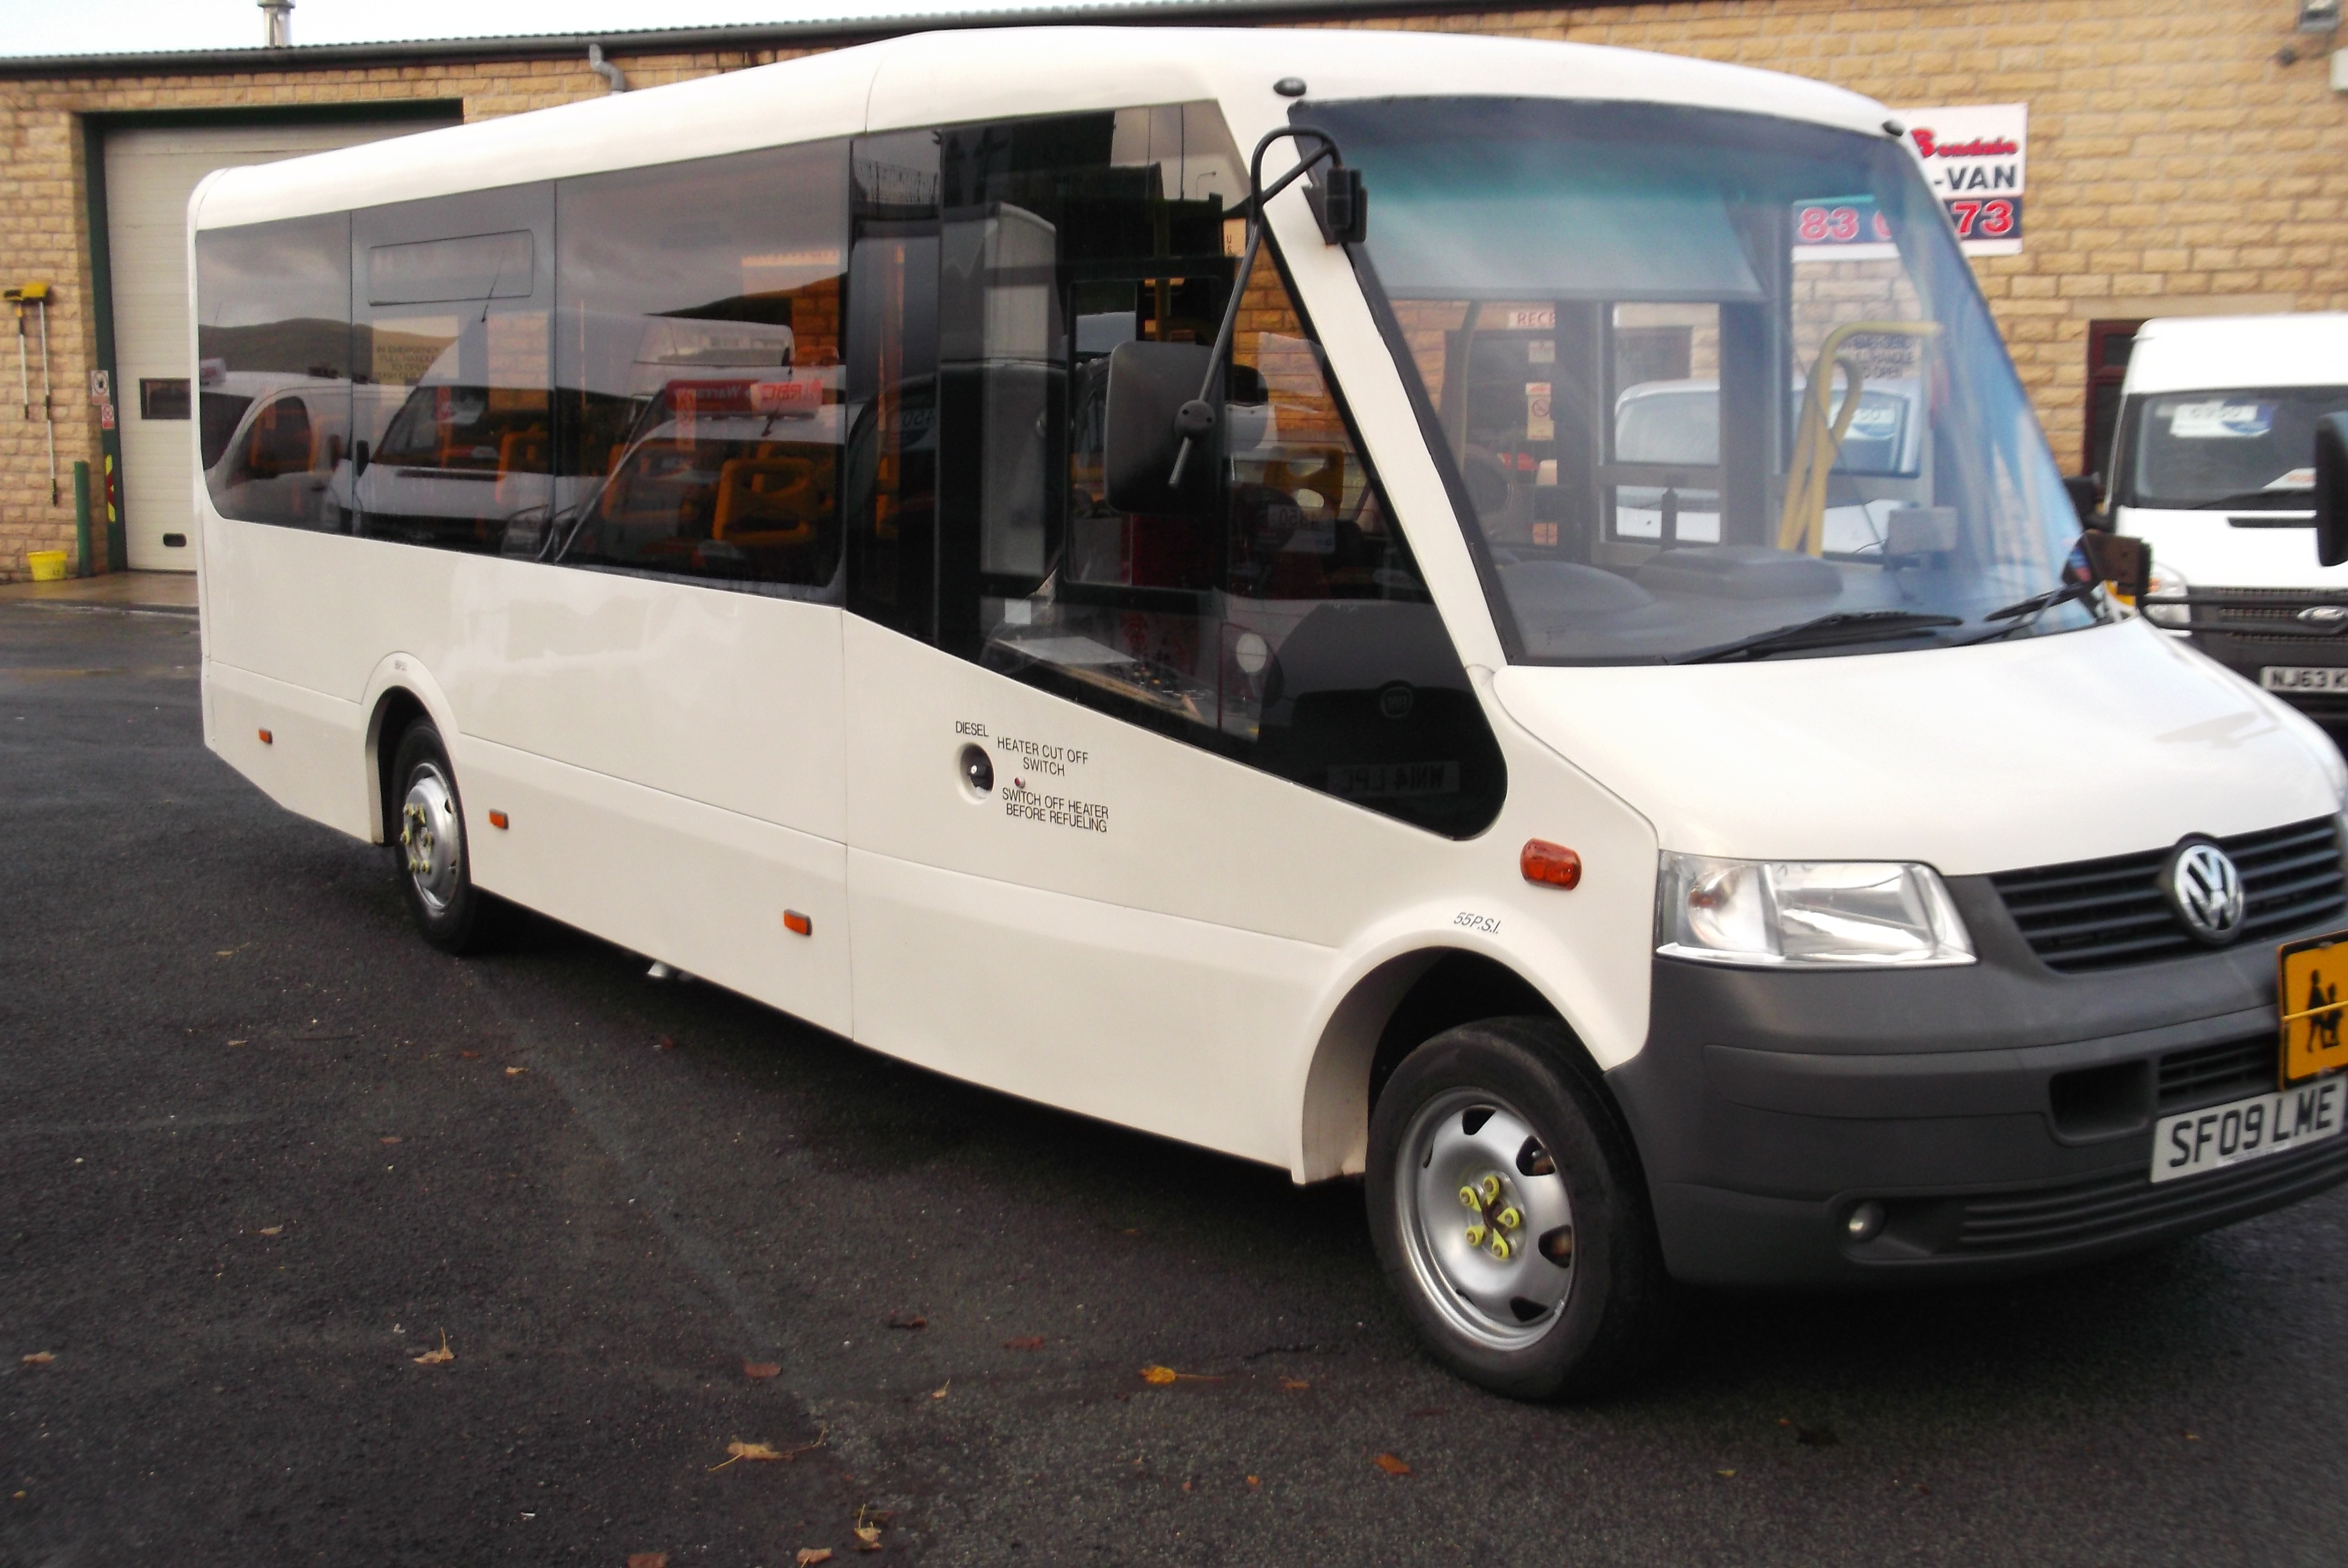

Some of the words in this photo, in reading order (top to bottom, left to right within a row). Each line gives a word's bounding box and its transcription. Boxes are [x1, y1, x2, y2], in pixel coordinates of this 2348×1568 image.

[1800, 206, 1858, 241] 83
[1952, 199, 2013, 235] 73
[956, 721, 989, 737] DIESEL
[997, 736, 1039, 756] HEATER
[1043, 745, 1063, 760] CUT
[1067, 750, 1088, 764] OFF
[1023, 757, 1064, 776] SWITCH
[1003, 787, 1040, 806] SWITCH
[1045, 795, 1064, 811] OFF
[1068, 800, 1108, 819] HEATER
[1006, 803, 1045, 821] BEFORE
[1050, 810, 1107, 833] REFUELING
[2168, 1103, 2266, 1168] SF09
[2272, 1082, 2338, 1143] LME
